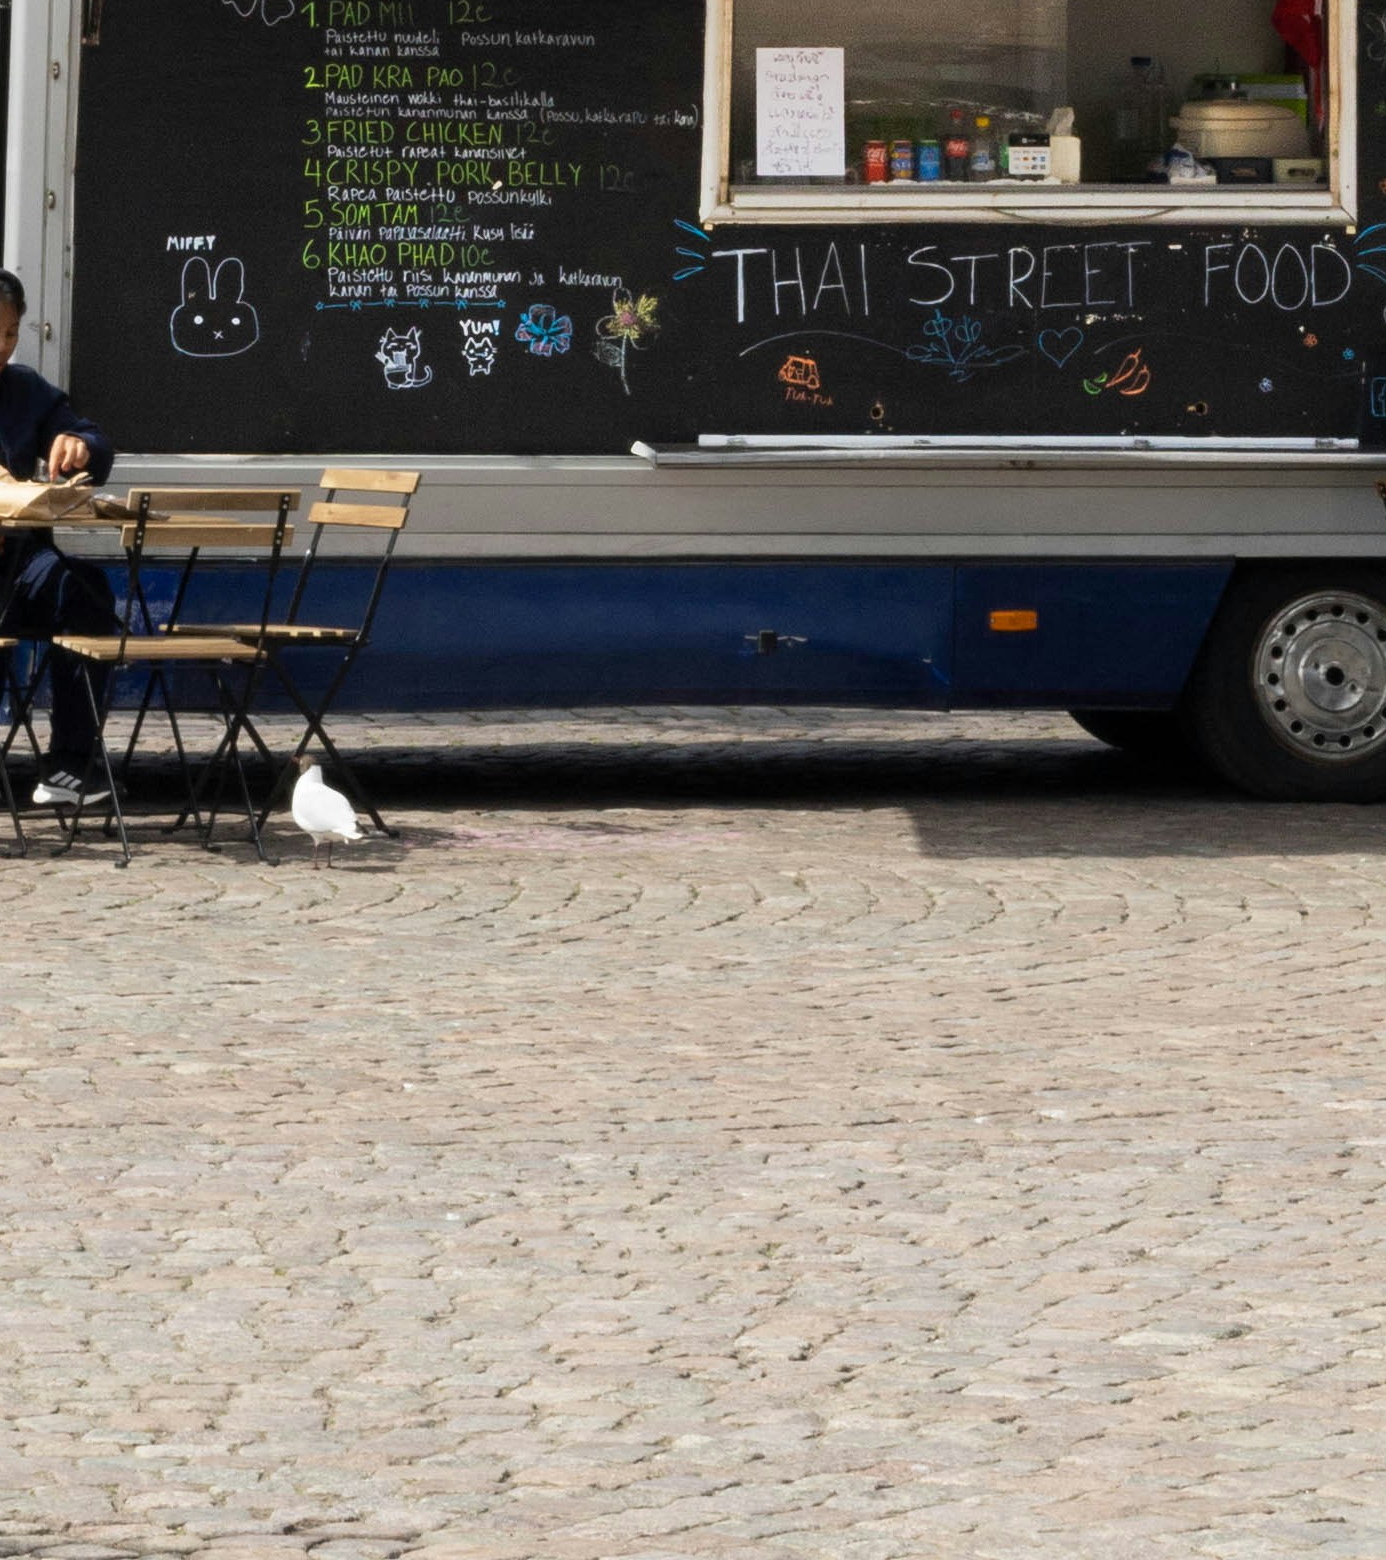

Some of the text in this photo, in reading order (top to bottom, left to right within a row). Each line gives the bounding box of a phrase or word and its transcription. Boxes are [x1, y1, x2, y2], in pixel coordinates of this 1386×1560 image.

[328, 0, 371, 26] PAD
[325, 28, 388, 45] Paistettu
[393, 27, 441, 45] nuudeli
[515, 28, 595, 47] katkaravun
[323, 44, 441, 58] tai kanan kanssa
[325, 63, 365, 89] PAD
[372, 64, 414, 89] KRA
[426, 65, 465, 89] PAO
[324, 89, 555, 108] Mausteinen wokki thai-basilikalla
[397, 106, 478, 120] kananmunan
[486, 108, 528, 121] kanssa
[326, 119, 395, 144] FRIED
[405, 120, 503, 146] CHICKEN
[400, 145, 445, 159] rapeat
[454, 145, 527, 160] kanansiivet
[325, 159, 419, 187] CRISPY
[436, 159, 495, 186] PORK
[507, 161, 582, 188] BELLY
[326, 185, 377, 202] Rapea
[329, 201, 372, 227] SOM
[373, 201, 419, 226] TAM
[327, 240, 388, 268] KHAO
[397, 241, 455, 267] PHAD
[326, 265, 623, 288] Paistettu riisi kananmunan ja katkaravun
[711, 240, 1352, 325] THAI STREET FOOD
[328, 283, 373, 298] kanan
[379, 283, 398, 298] tai
[453, 283, 498, 299] kanssa
[459, 318, 501, 337] YUM!
